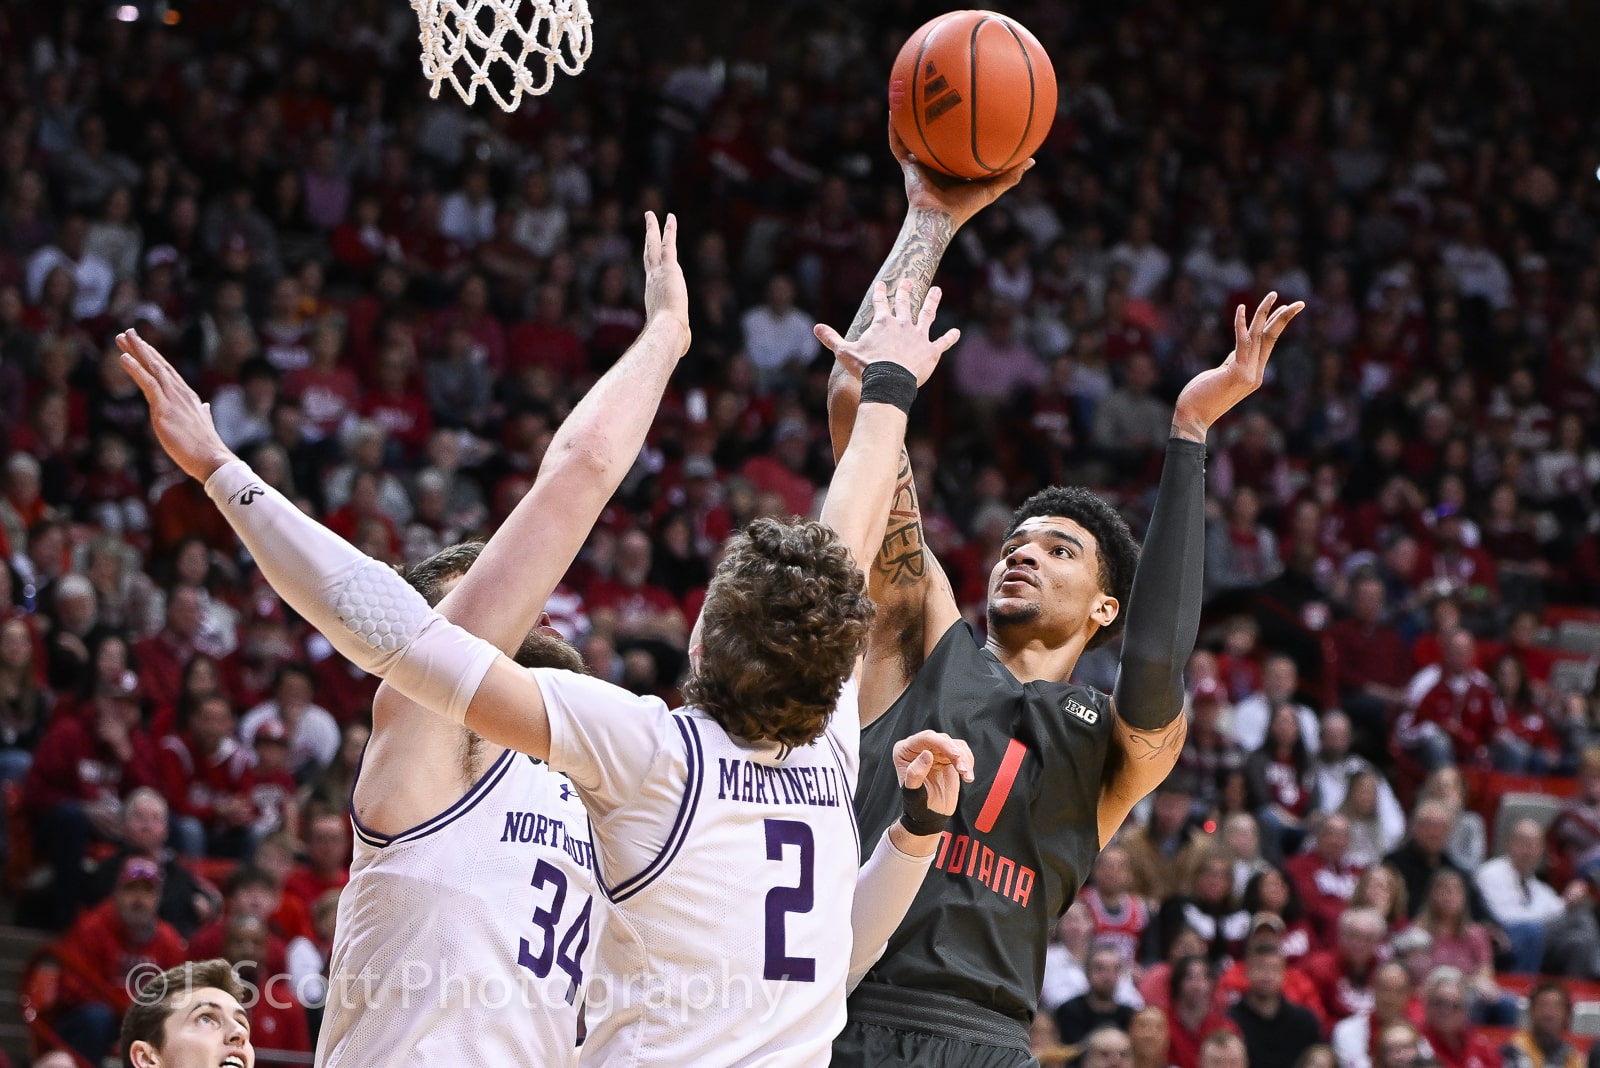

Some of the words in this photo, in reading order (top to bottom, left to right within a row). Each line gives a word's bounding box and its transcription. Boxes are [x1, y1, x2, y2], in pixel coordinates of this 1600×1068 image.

[718, 758, 840, 807] MARTINELLI
[974, 738, 1027, 833] 1
[763, 818, 816, 982] 2
[935, 830, 1036, 908] NDIANA
[518, 858, 593, 1006] 34
